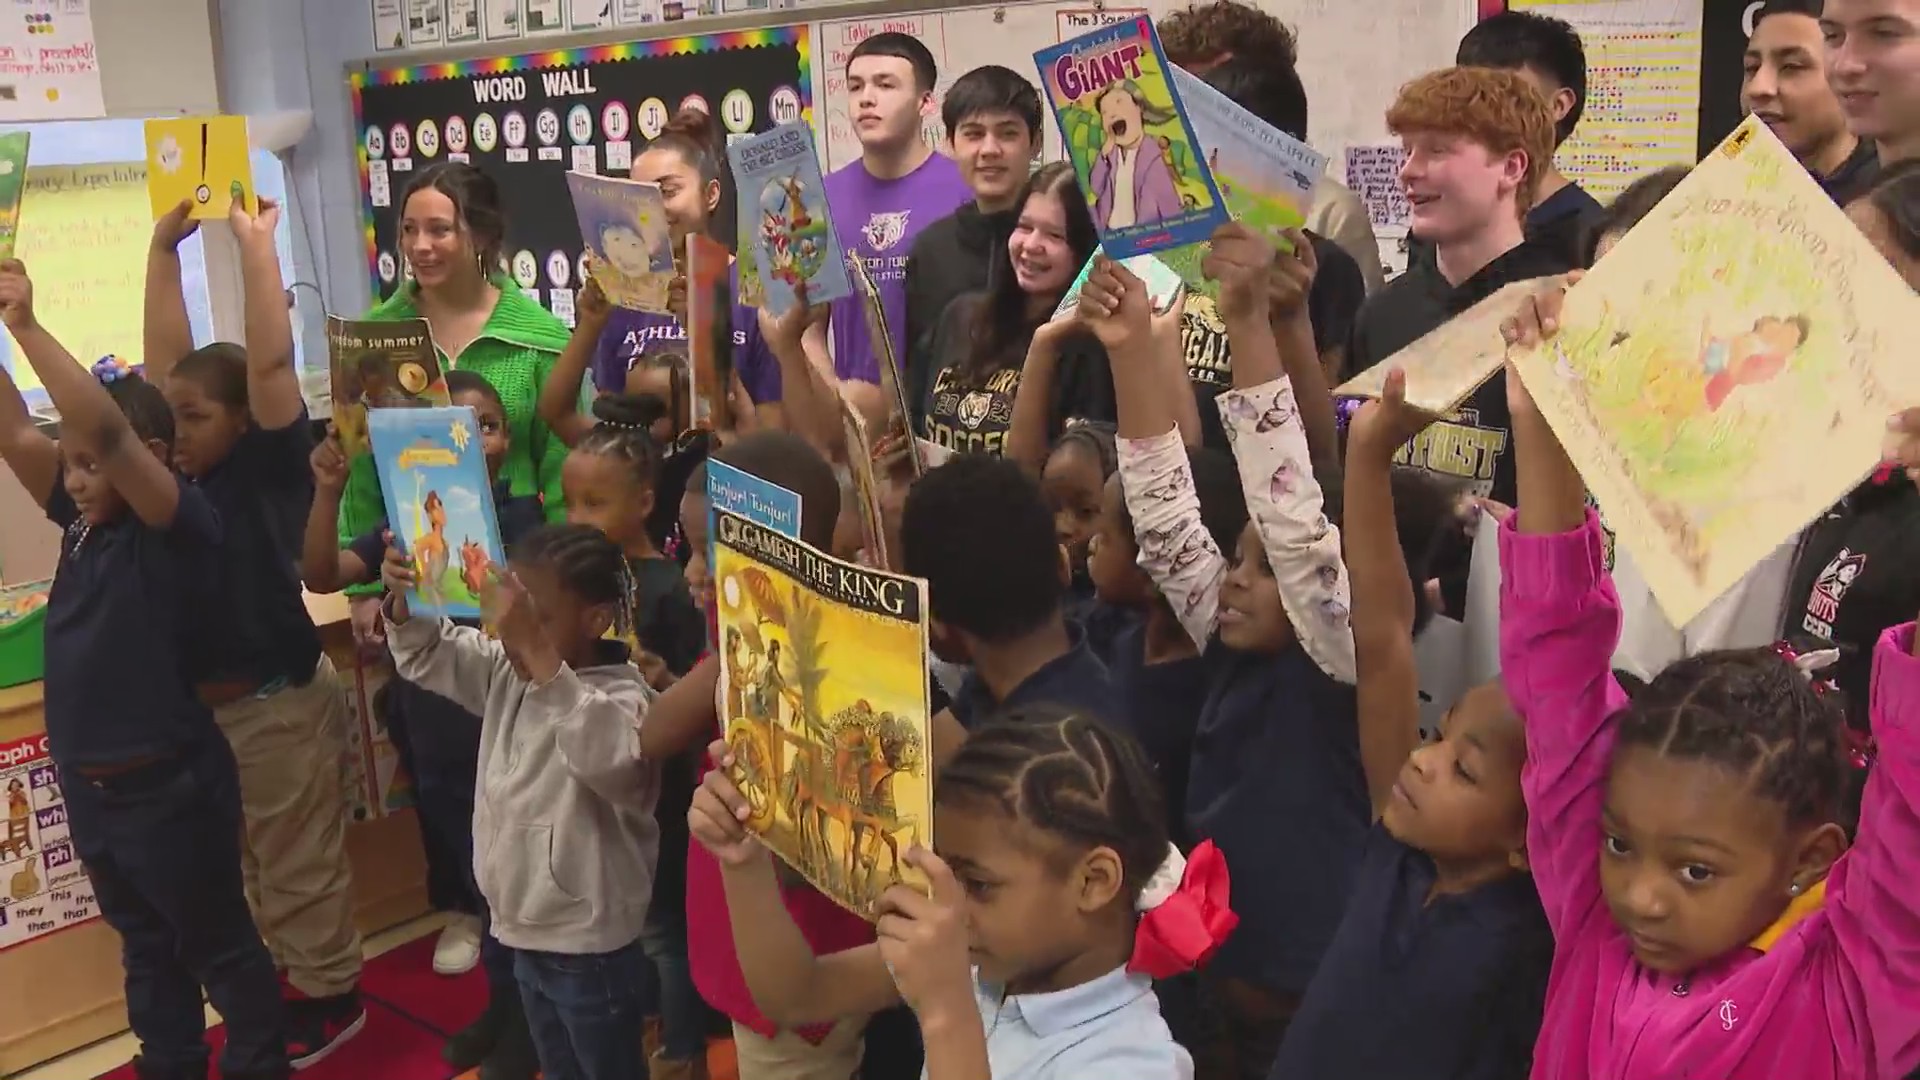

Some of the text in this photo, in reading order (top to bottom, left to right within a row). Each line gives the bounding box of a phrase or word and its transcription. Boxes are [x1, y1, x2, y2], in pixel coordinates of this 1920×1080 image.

[1067, 14, 1089, 26] The
[473, 67, 597, 103] WORD WALL
[774, 98, 795, 119] Mm
[539, 115, 555, 139] Gg
[368, 336, 424, 348] summer
[802, 551, 835, 586] THE
[839, 568, 905, 614] KING
[34, 769, 54, 786] sh
[39, 809, 64, 828] wh
[48, 848, 69, 870] ph
[50, 890, 71, 902] this
[16, 907, 44, 919] they
[63, 907, 88, 920] that
[27, 920, 55, 933] then
